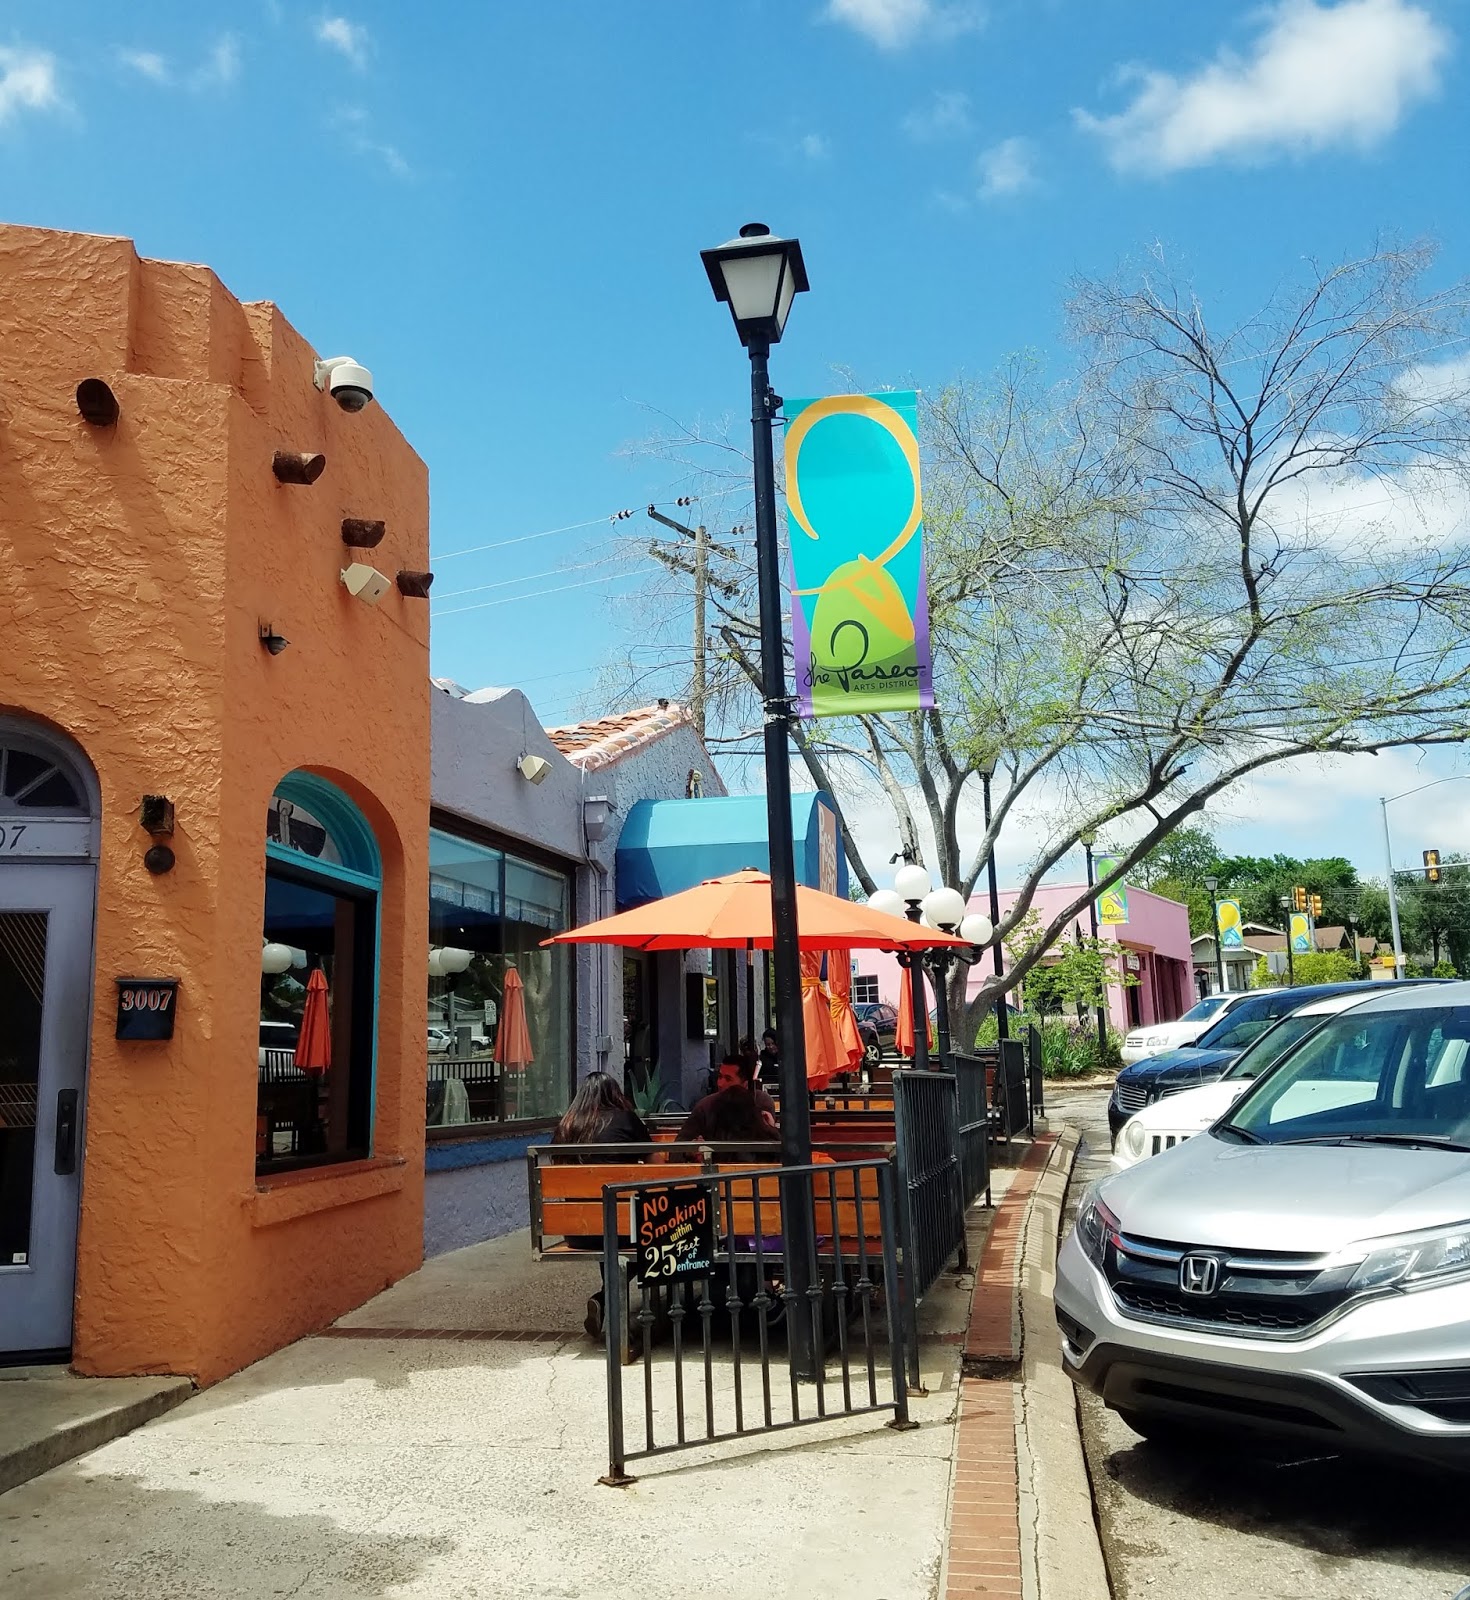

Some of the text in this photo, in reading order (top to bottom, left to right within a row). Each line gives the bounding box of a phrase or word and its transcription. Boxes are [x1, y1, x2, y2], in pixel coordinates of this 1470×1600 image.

[820, 619, 926, 693] Paseo
[853, 679, 919, 692] ARTS DISTRICT
[121, 989, 173, 1011] 3007
[643, 1195, 669, 1221] NO
[640, 1198, 706, 1247] Smoking
[669, 1223, 693, 1242] within
[644, 1236, 700, 1279] 25 Feet
[688, 1247, 698, 1259] of
[676, 1258, 710, 1272] entrance
